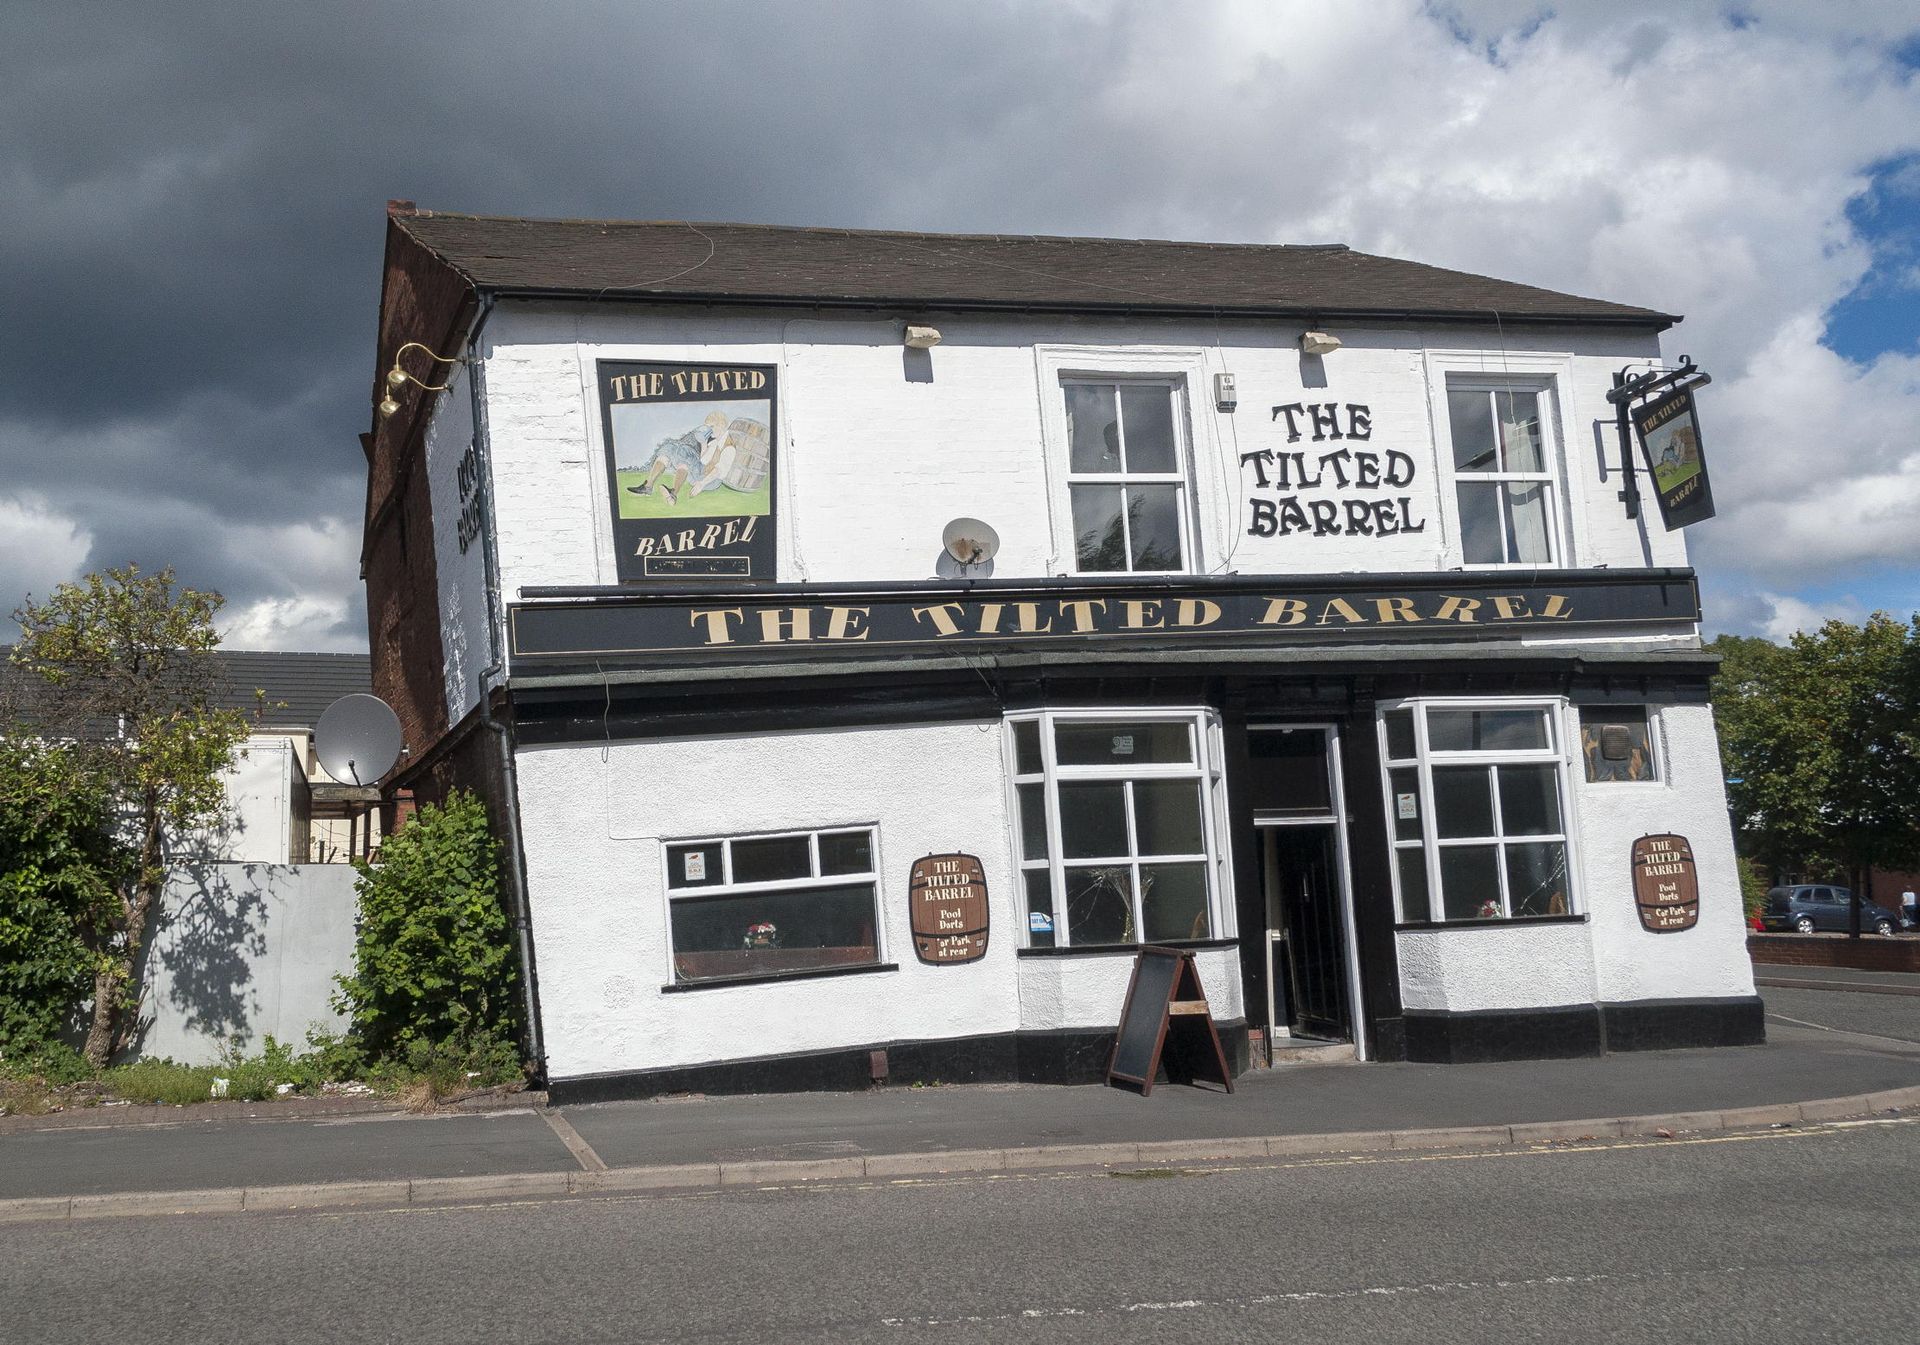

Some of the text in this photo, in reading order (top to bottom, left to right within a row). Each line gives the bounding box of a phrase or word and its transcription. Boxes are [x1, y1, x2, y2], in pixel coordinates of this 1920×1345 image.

[611, 370, 766, 401] THE TILTED
[1272, 402, 1372, 443] THE
[1642, 414, 1658, 433] THE
[1240, 448, 1415, 490] TILTED
[1247, 495, 1426, 538] BARREL
[633, 515, 758, 556] BARREL
[690, 594, 1574, 645] THE TILTED BARREL
[1650, 840, 1671, 851] THE
[1644, 851, 1680, 864] TILTED
[934, 861, 960, 873] THE
[1644, 863, 1685, 877] BARREL
[925, 873, 970, 887] TILTED
[1659, 882, 1676, 892] Pool
[924, 887, 974, 901] BARREL
[1658, 892, 1679, 901] Darts
[940, 908, 961, 919] Pool
[1655, 906, 1686, 917] Car Park
[939, 920, 963, 929] Darts
[1660, 917, 1684, 926] at rear
[937, 935, 971, 947] ar Park
[939, 947, 968, 957] at rear
